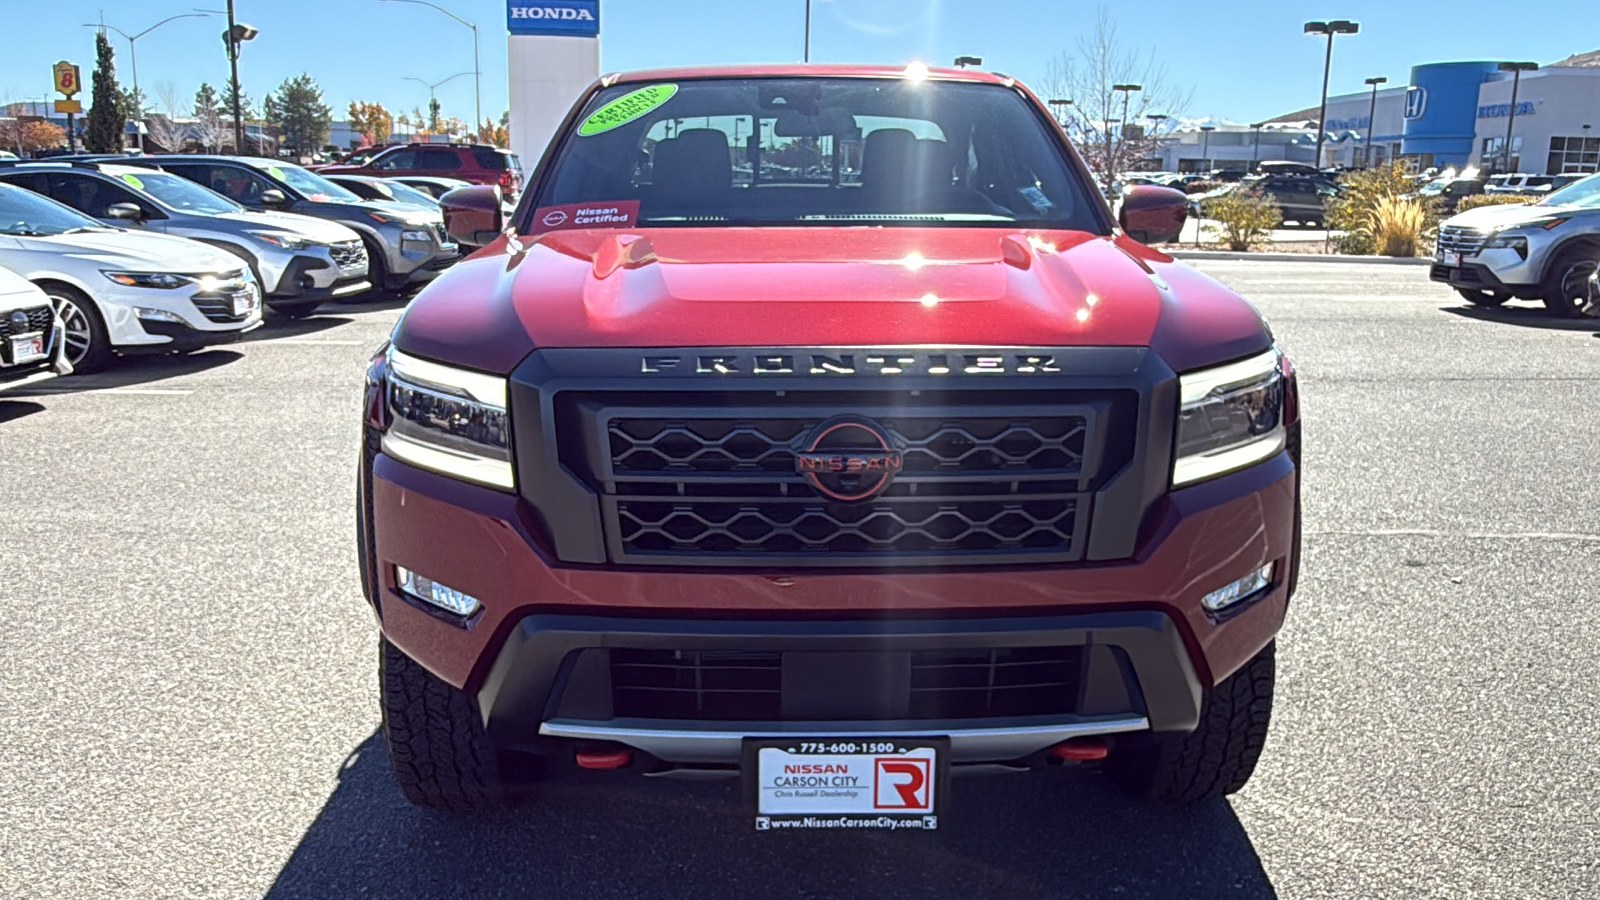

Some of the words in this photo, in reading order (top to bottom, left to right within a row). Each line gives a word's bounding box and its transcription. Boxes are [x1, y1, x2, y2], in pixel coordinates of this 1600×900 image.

[511, 7, 595, 20] HONDA
[60, 72, 73, 88] 8
[588, 88, 658, 124] CERTIFIED
[576, 208, 618, 216] Nissan
[574, 214, 629, 224] Certified
[641, 355, 1061, 374] FRONTIER
[800, 456, 900, 471] NISSAN
[801, 743, 894, 753] 775-600-1500
[784, 764, 848, 774] NISSAN
[774, 776, 828, 787] CARSON
[831, 776, 859, 787] CITY
[774, 790, 793, 798] Chris
[794, 789, 818, 798] Russell
[819, 789, 859, 799] Dealership
[771, 816, 922, 830] www.NissanCarsonCity.com
